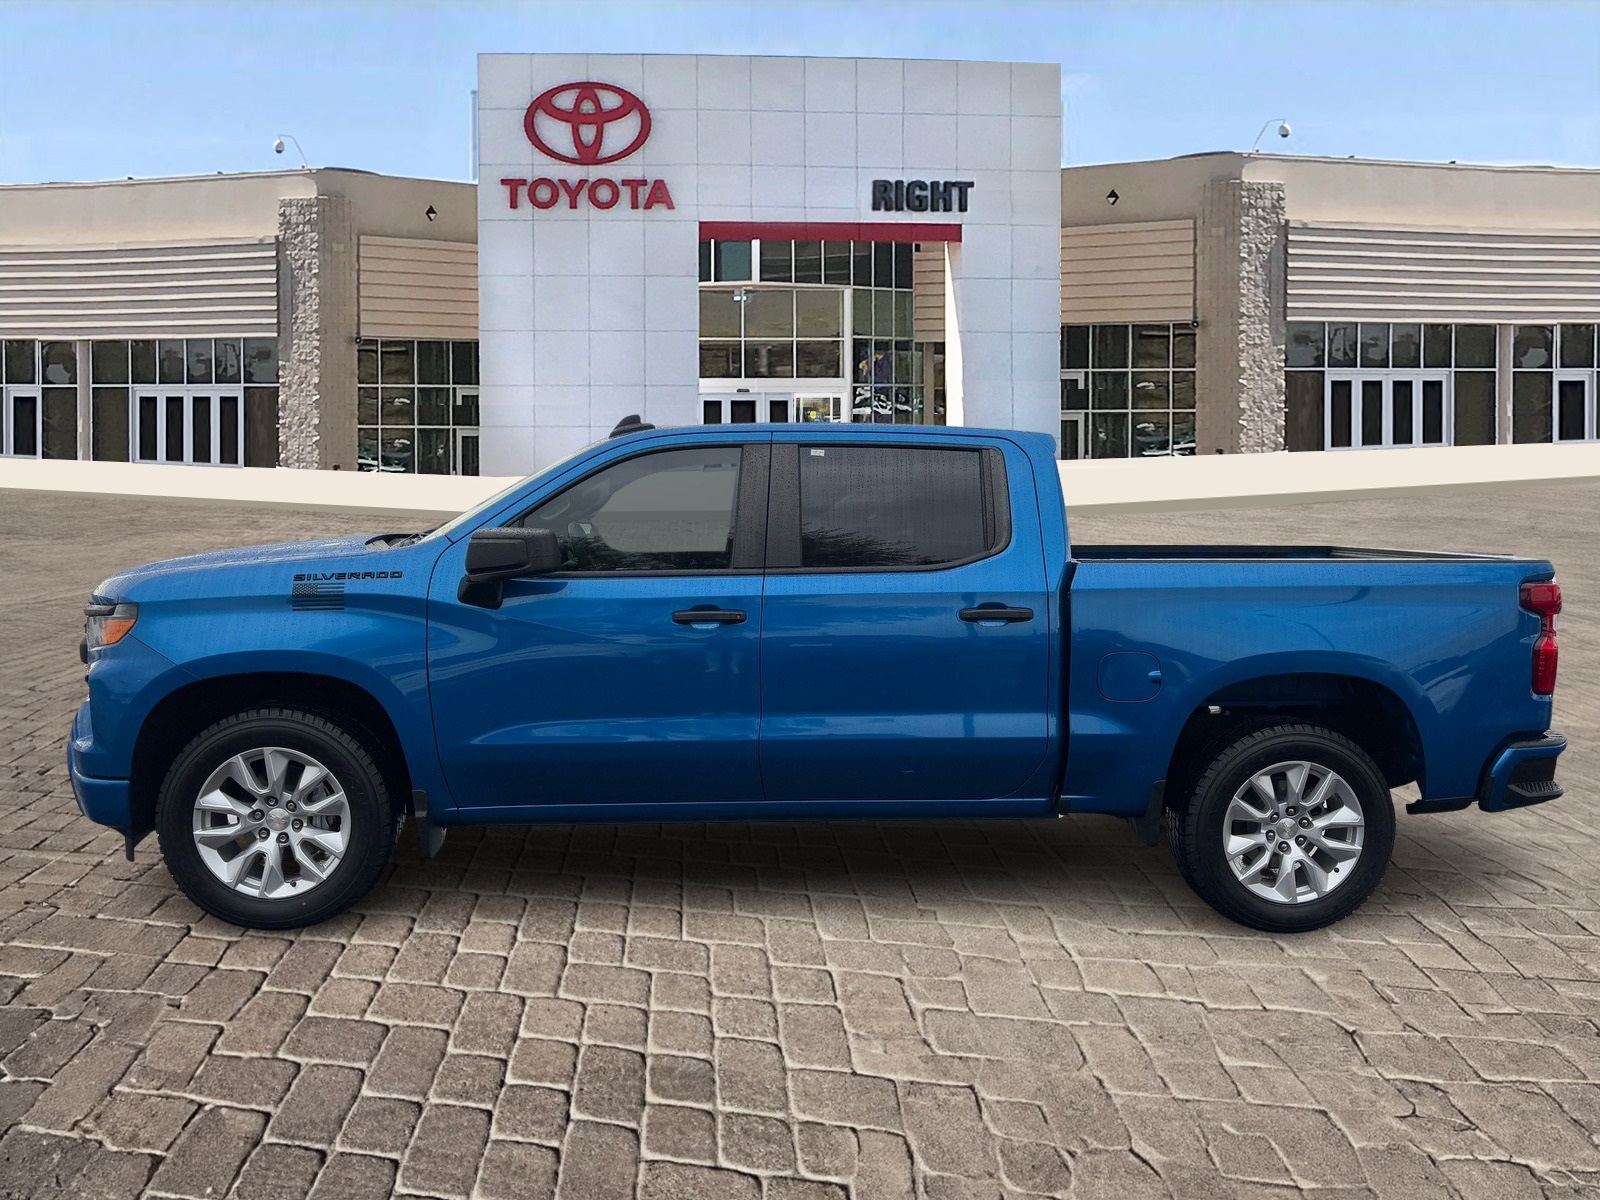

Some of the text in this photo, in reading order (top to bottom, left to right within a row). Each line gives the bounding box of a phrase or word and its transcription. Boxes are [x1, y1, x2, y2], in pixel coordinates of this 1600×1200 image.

[500, 177, 675, 210] TOYOTA
[871, 179, 975, 213] RIGHT
[292, 570, 403, 581] SILVERADO
